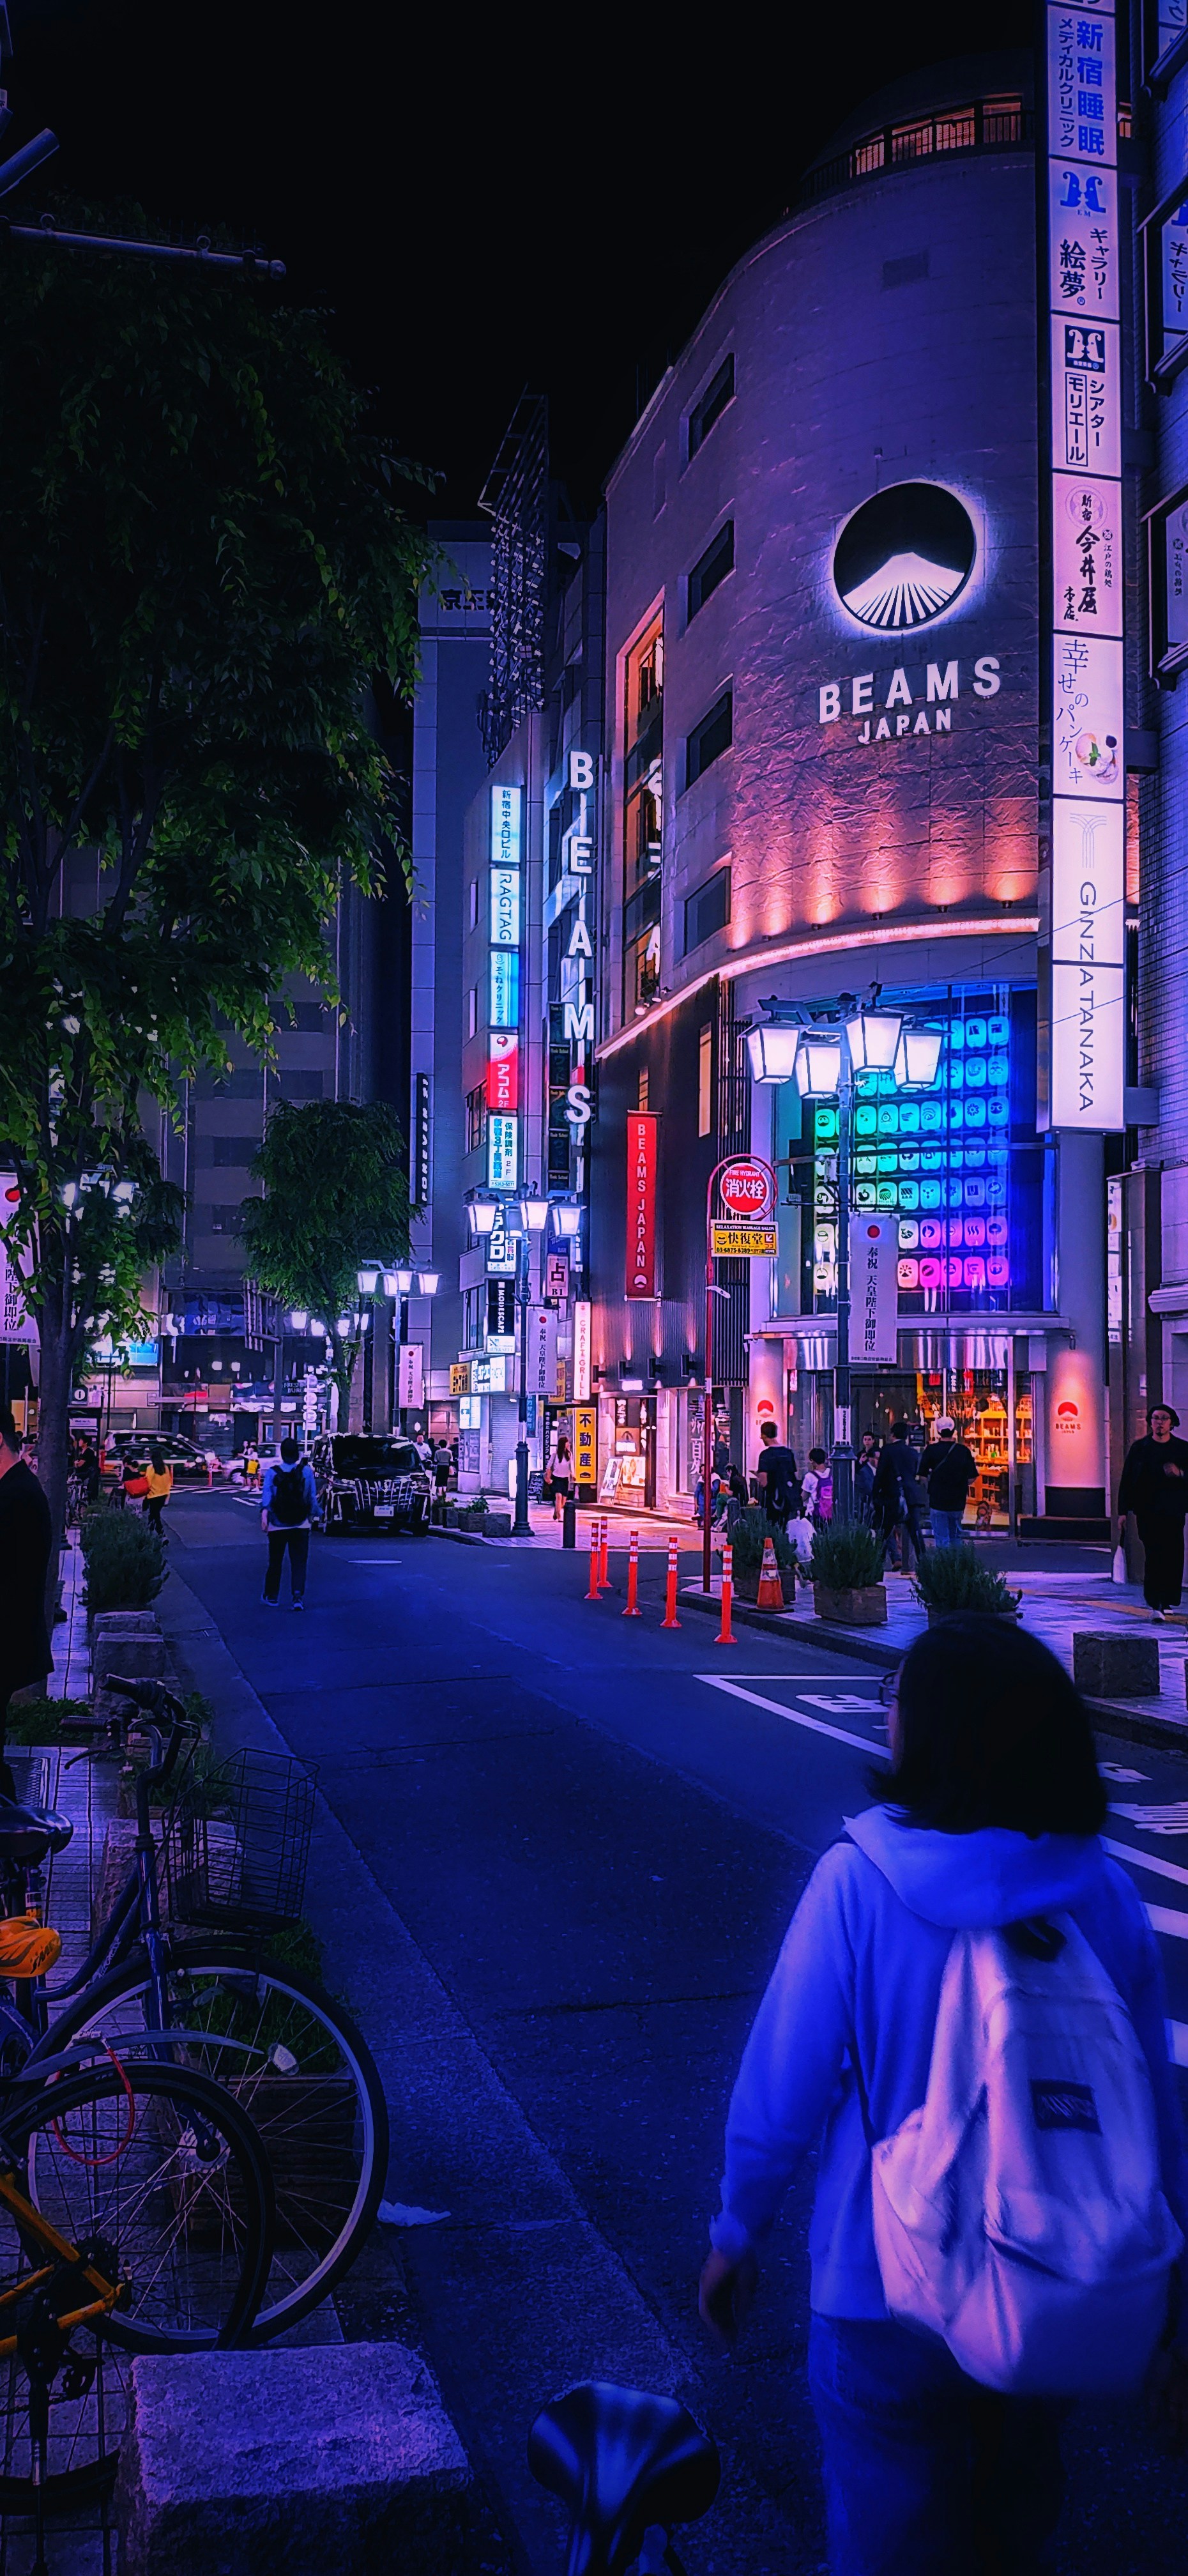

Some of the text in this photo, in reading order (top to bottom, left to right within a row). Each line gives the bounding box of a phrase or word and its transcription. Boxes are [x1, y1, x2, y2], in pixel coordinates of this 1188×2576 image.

[1058, 18, 1075, 148] メディカルクリニック
[1077, 20, 1105, 155] 新宿睡眠
[1060, 238, 1086, 298] 絵夢
[1090, 228, 1109, 300] ギャラリー
[1069, 377, 1085, 461] モリエール
[1090, 380, 1104, 447] シアター
[1076, 525, 1100, 615] 今井屋
[819, 656, 1000, 724] BEAMS
[1056, 640, 1089, 784] 幸せのパンケーキ
[857, 709, 952, 744] JAPAN
[501, 790, 511, 858] 新宿中央口ビル
[500, 873, 512, 940] RAGTAG
[564, 751, 594, 1124] BEAMS
[496, 967, 504, 1023] そねクリニック
[498, 1064, 510, 1098] アコム
[505, 1123, 513, 1156] 保険調剤
[636, 1124, 647, 1267] BEAMS JAPAN
[726, 1178, 765, 1200] 消火栓
[551, 1262, 565, 1282] 占
[728, 1232, 763, 1245] 快復堂
[864, 1246, 878, 1351] 奉祝 天皇陛下御即位
[579, 1414, 591, 1466] 不動産
